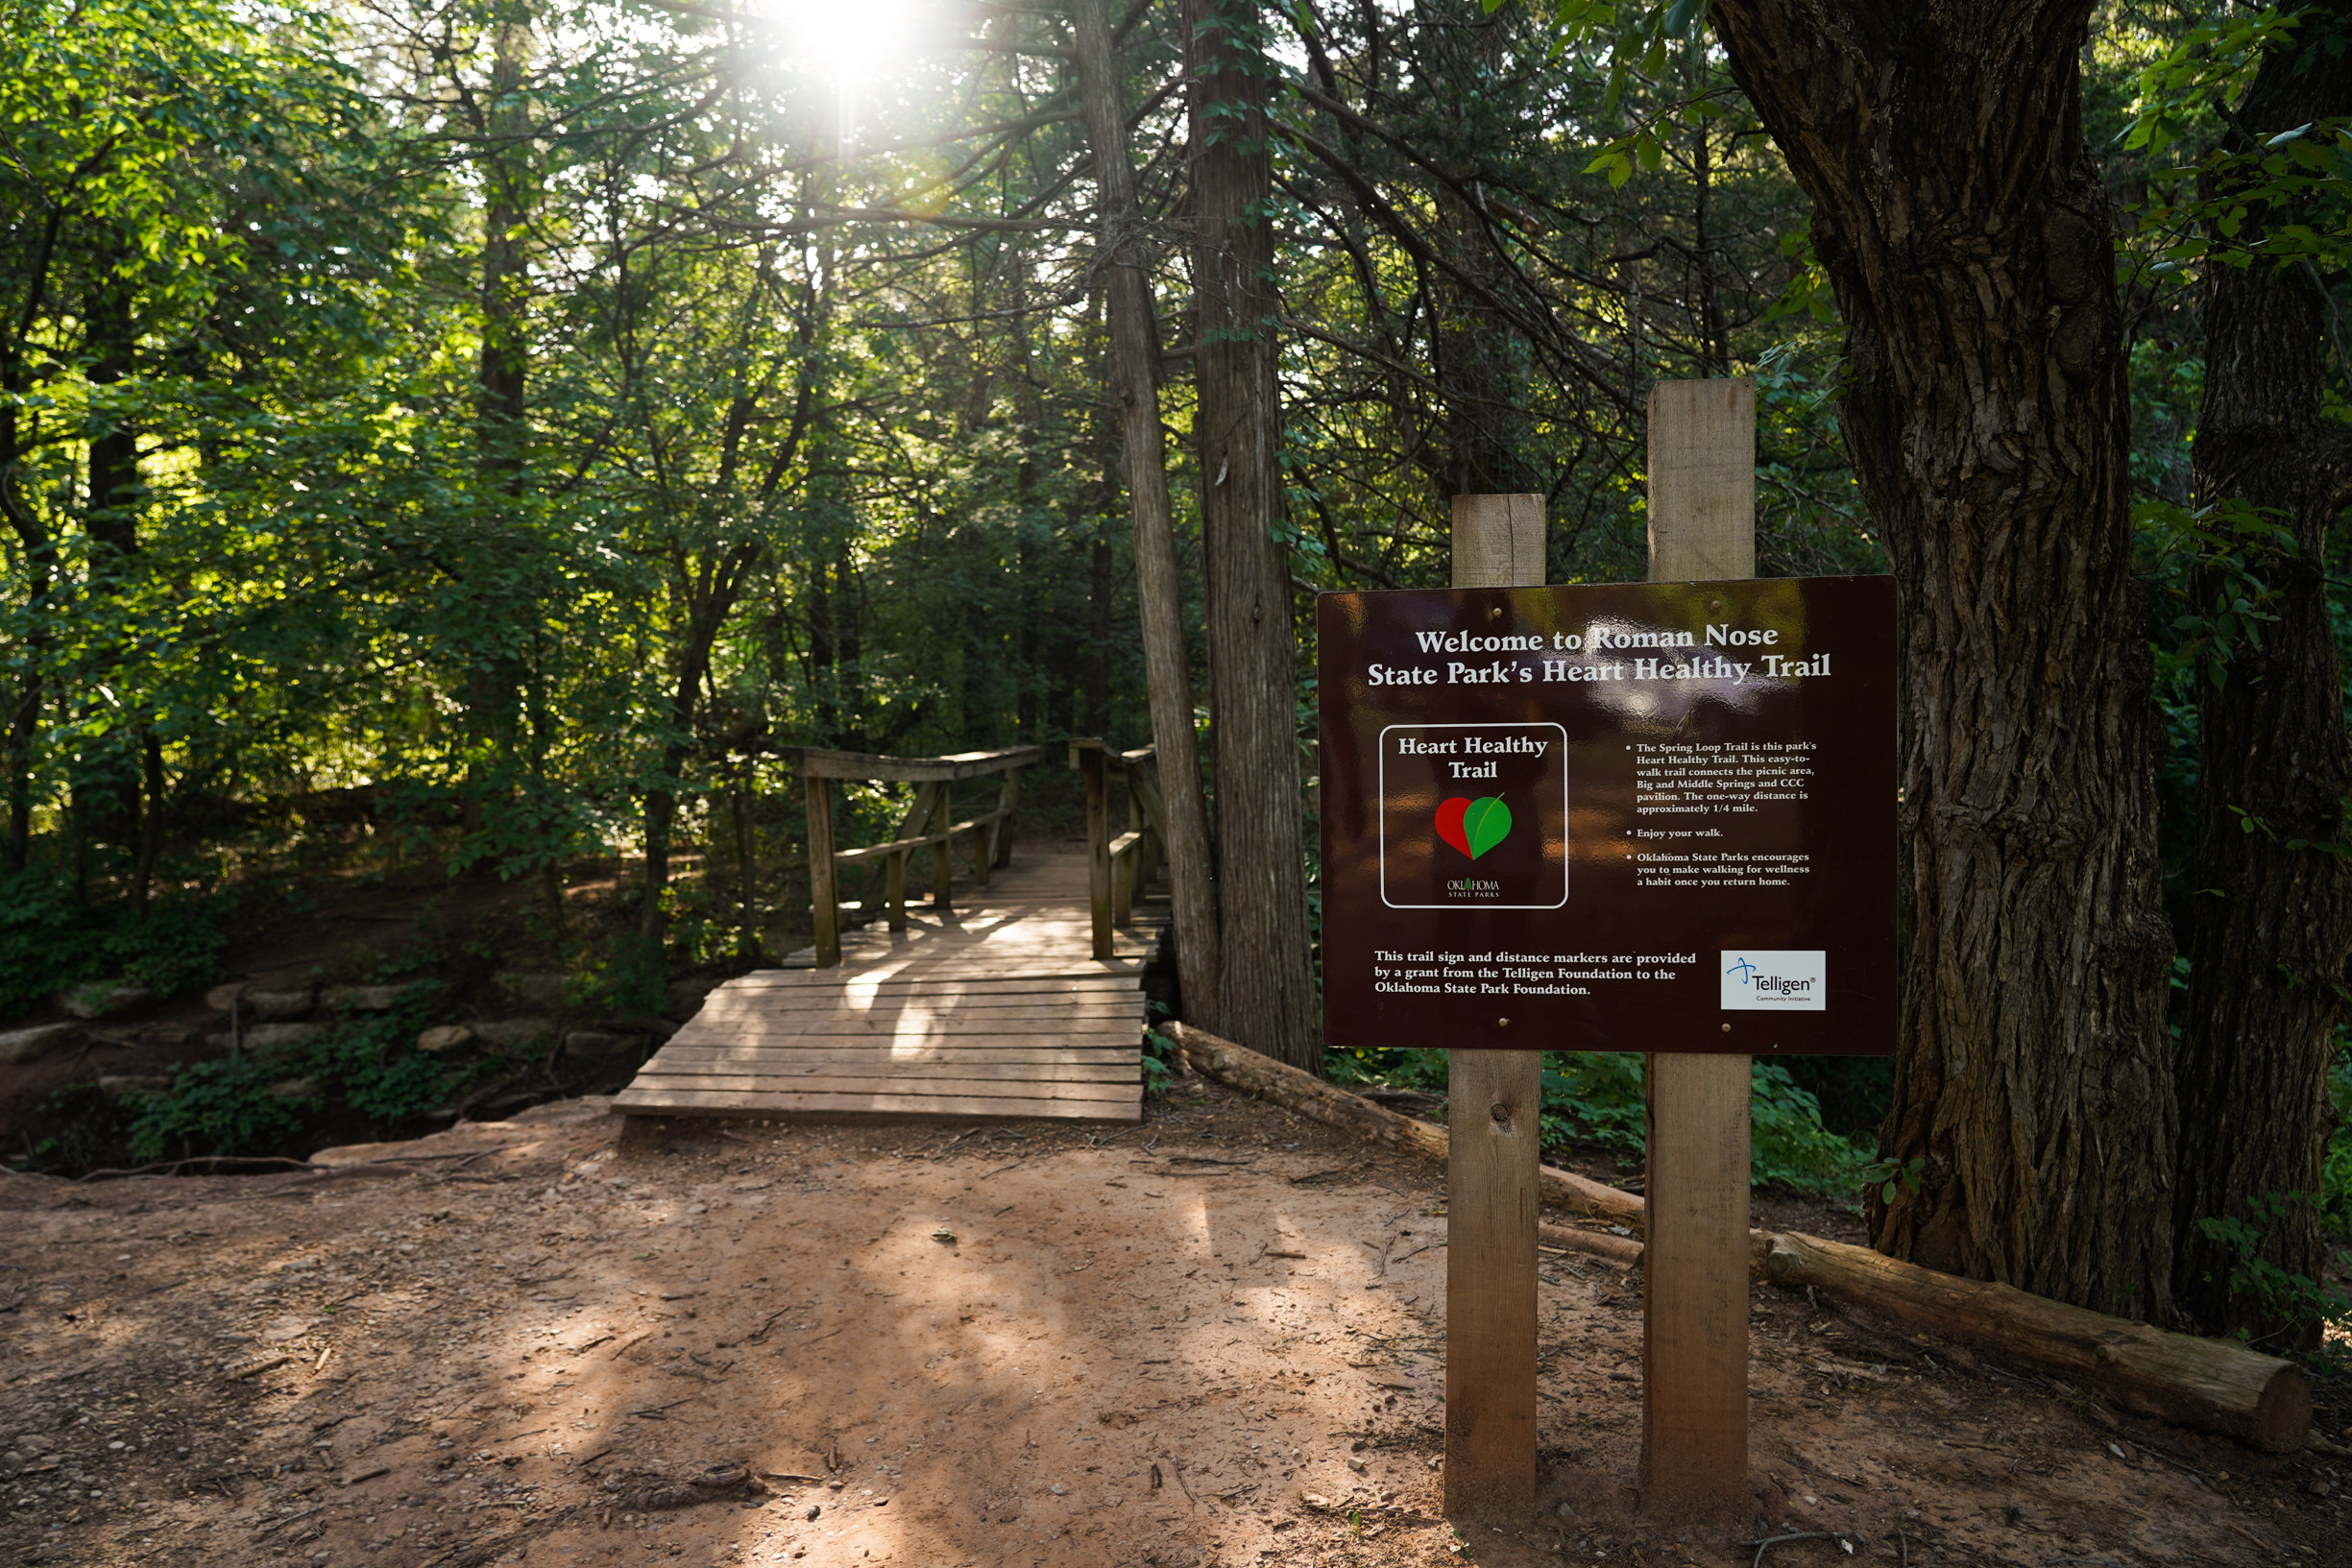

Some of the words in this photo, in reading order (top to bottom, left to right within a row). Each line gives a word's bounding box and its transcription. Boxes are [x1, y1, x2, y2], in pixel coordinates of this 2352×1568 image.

[1416, 630, 1543, 653] Welcome
[1553, 631, 1581, 650] to
[1592, 627, 1694, 649] Roman
[1704, 624, 1778, 646] Nose
[1369, 663, 1438, 686] State
[1542, 661, 1623, 682] Heart
[1635, 656, 1752, 685] Healthy
[1760, 653, 1831, 677] Trail
[1398, 738, 1457, 754] Heart
[1465, 736, 1548, 758] Healthy
[1660, 744, 1692, 754] Spring
[1696, 743, 1721, 753] Loop
[1724, 742, 1748, 751] Trail
[1752, 742, 1759, 751] is
[1763, 742, 1782, 751] this
[1668, 756, 1709, 765] Healthy
[1711, 755, 1738, 763] Trail.
[1742, 755, 1765, 763] This
[1768, 756, 1809, 764] easy-to-
[1448, 761, 1497, 778] Trail
[1637, 768, 1661, 777] walk
[1736, 767, 1753, 776] the
[1757, 767, 1786, 777] picnic
[1637, 781, 1653, 790] Big
[1678, 780, 1713, 788] Middle
[1716, 780, 1755, 789] Springs
[1758, 779, 1777, 787] and
[1781, 779, 1805, 787] CCC
[1637, 793, 1681, 803] pavilion.
[1684, 792, 1704, 801] The
[1754, 791, 1796, 800] distance
[1800, 791, 1808, 800] is
[1637, 805, 1709, 815] approximately
[1733, 804, 1758, 812] mile.
[1637, 830, 1665, 839] Enjoy
[1695, 829, 1723, 837] walk.
[1752, 854, 1809, 863] encourages
[1637, 867, 1656, 876] you
[1673, 865, 1700, 874] make
[1703, 865, 1743, 876] walking
[1747, 865, 1761, 874] for
[1765, 865, 1809, 874] wellness
[1646, 878, 1671, 886] habit
[1758, 878, 1790, 886] home.
[1374, 951, 1403, 961] This
[1407, 952, 1434, 962] trail
[1438, 951, 1465, 965] sign
[1468, 952, 1492, 962] and
[1495, 952, 1550, 963] distance
[1554, 953, 1608, 964] markers
[1612, 954, 1633, 964] are
[1637, 953, 1696, 966] provided
[1374, 967, 1391, 979] by
[1405, 968, 1439, 980] grant
[1443, 967, 1474, 978] from
[1478, 968, 1498, 978] the
[1502, 968, 1554, 981] Telligen
[1558, 969, 1633, 979] Foundation
[1636, 970, 1650, 979] to
[1654, 970, 1676, 979] the
[1374, 982, 1440, 993] Oklahoma
[1443, 983, 1477, 994] State
[1480, 983, 1510, 995] Park
[1513, 983, 1590, 995] Foundation.
